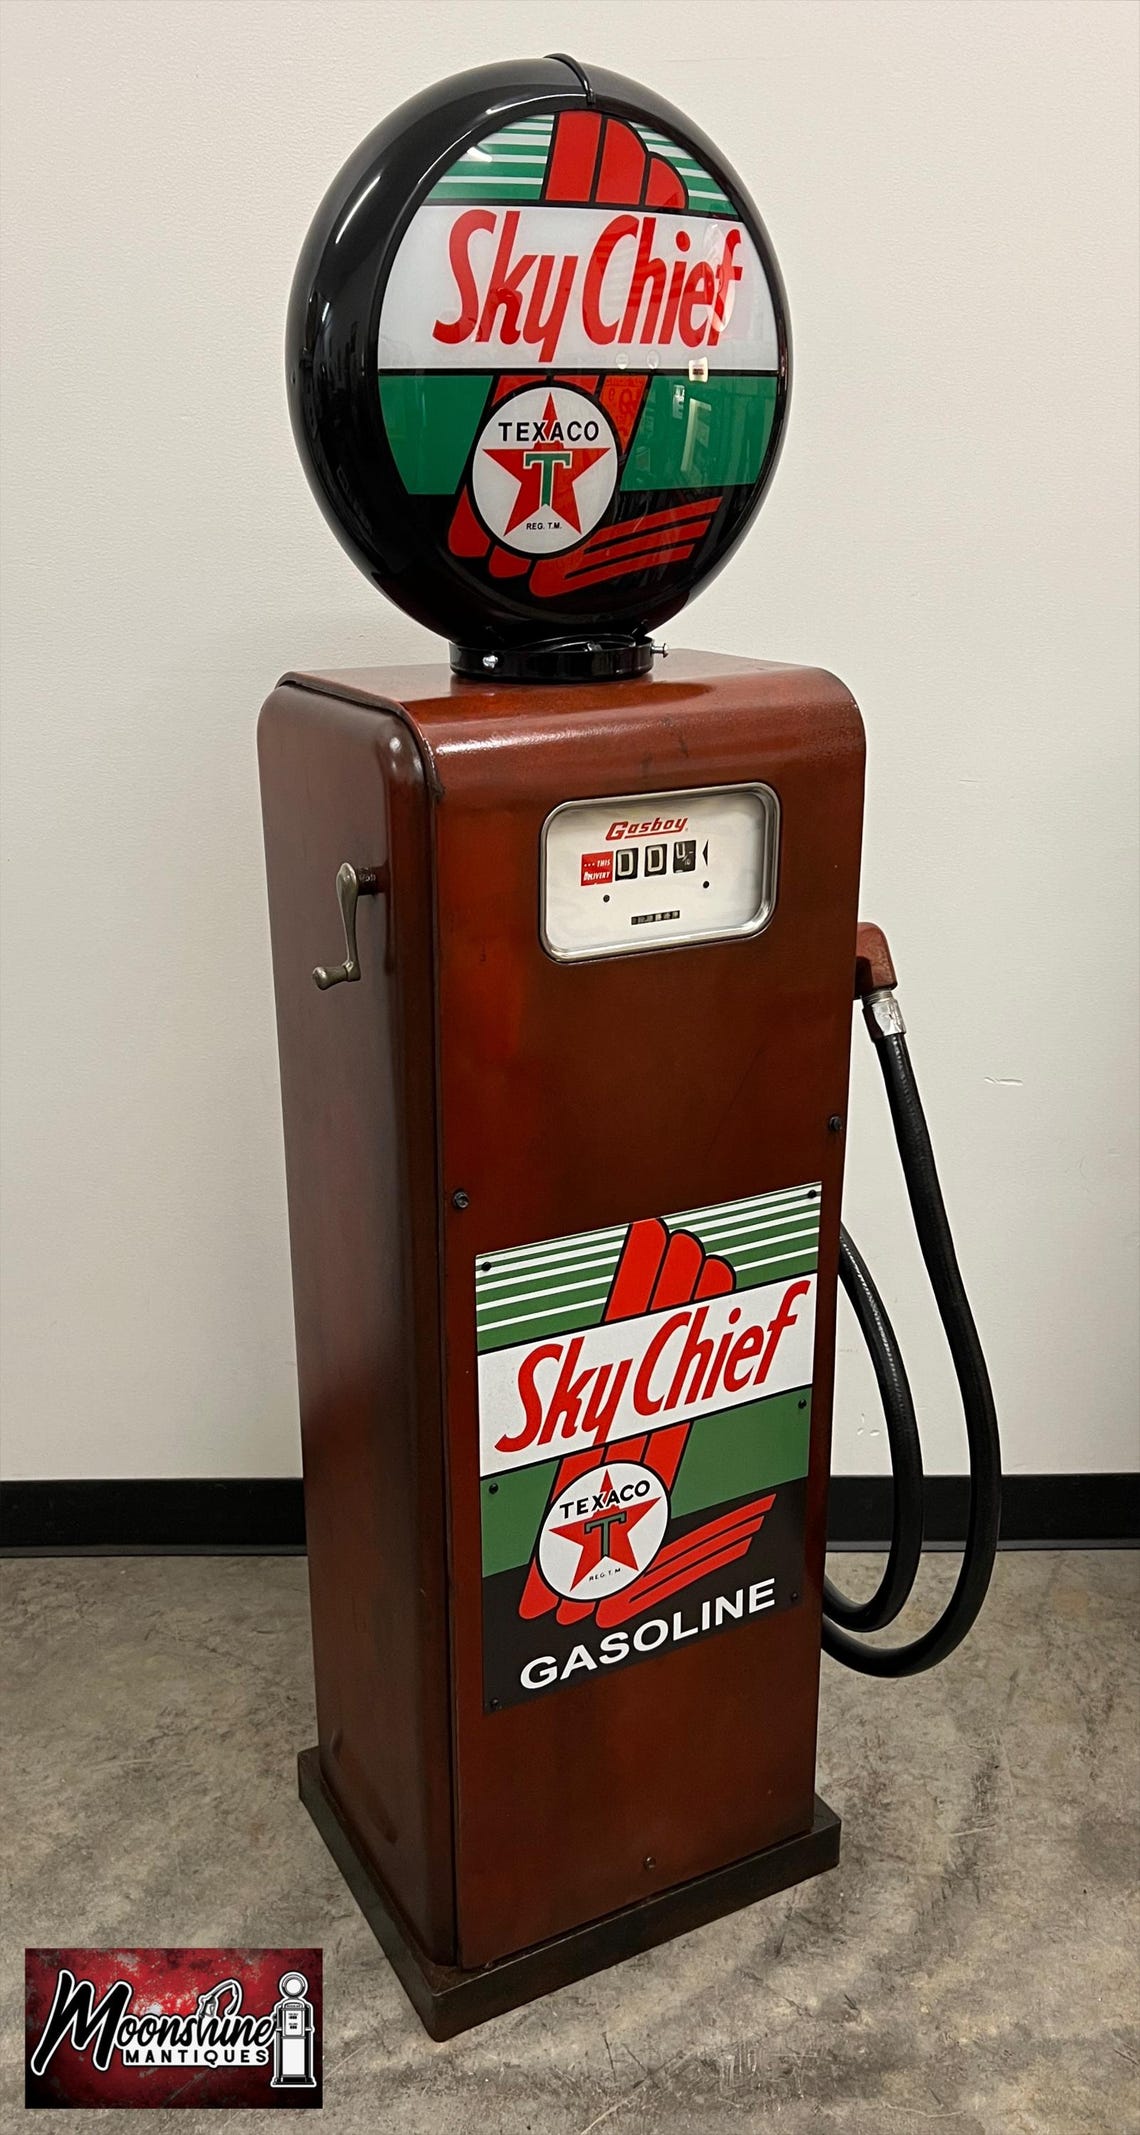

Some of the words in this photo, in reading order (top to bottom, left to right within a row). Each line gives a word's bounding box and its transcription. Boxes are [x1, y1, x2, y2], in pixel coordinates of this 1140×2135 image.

[432, 210, 577, 363] Sky
[582, 214, 743, 348] Chief
[498, 421, 599, 442] TEXACO
[523, 451, 573, 508] T
[526, 522, 545, 530] REG.
[605, 817, 688, 841] Gasboy
[494, 1336, 633, 1452] Sky
[632, 1279, 812, 1417] Chief
[560, 1480, 650, 1519] TEXACO
[584, 1510, 627, 1558] T
[520, 1578, 775, 1690] GASOLINE
